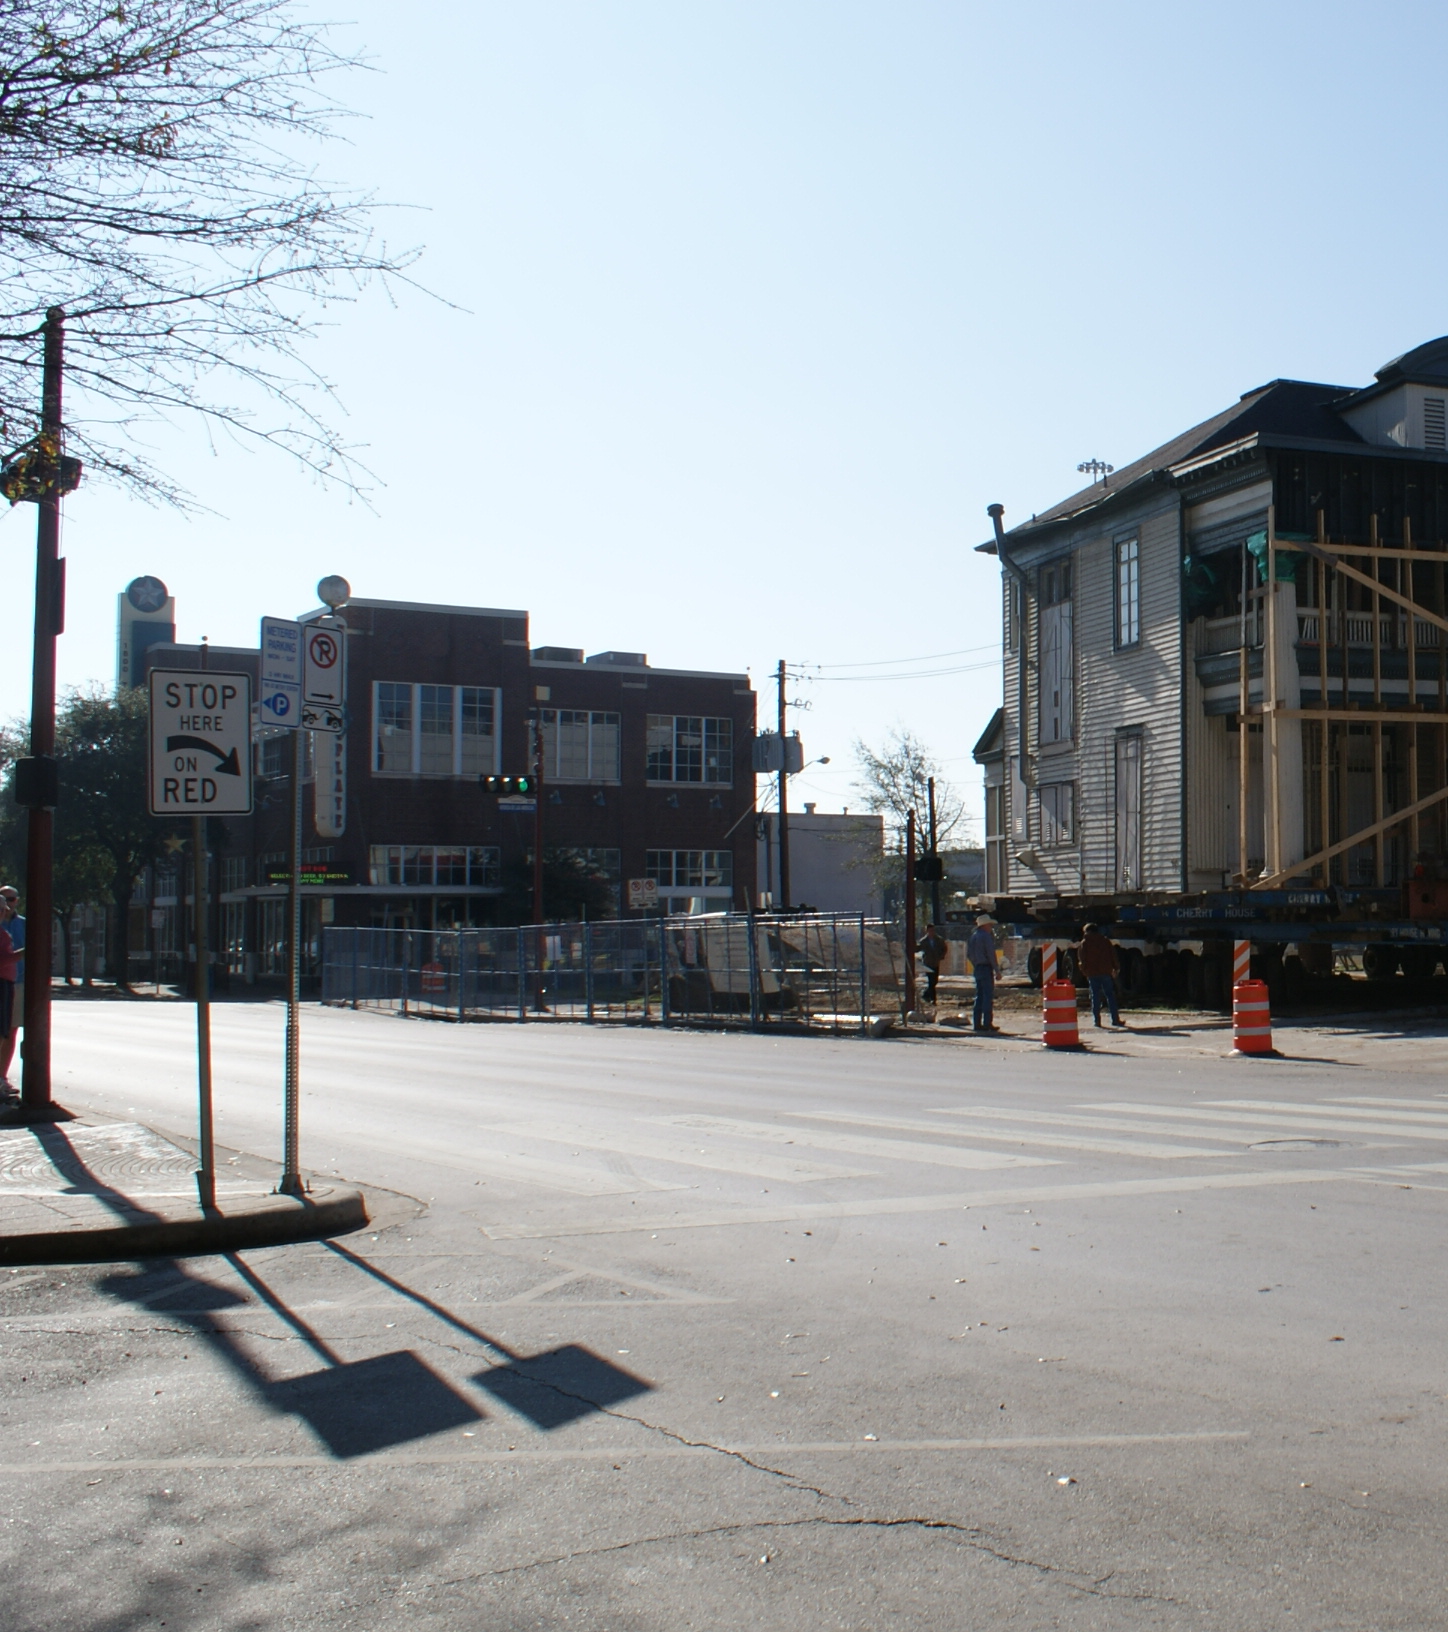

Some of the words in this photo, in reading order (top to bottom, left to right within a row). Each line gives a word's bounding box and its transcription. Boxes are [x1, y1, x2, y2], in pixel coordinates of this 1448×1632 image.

[266, 626, 298, 640] METERED
[268, 639, 297, 653] PARKING
[166, 682, 237, 710] STOP
[180, 715, 224, 731] HERE
[174, 756, 198, 772] ON
[163, 778, 217, 803] RED
[335, 743, 344, 829] PLATE
[1176, 908, 1214, 918] CHERRY
[1225, 908, 1256, 918] HOUSE
